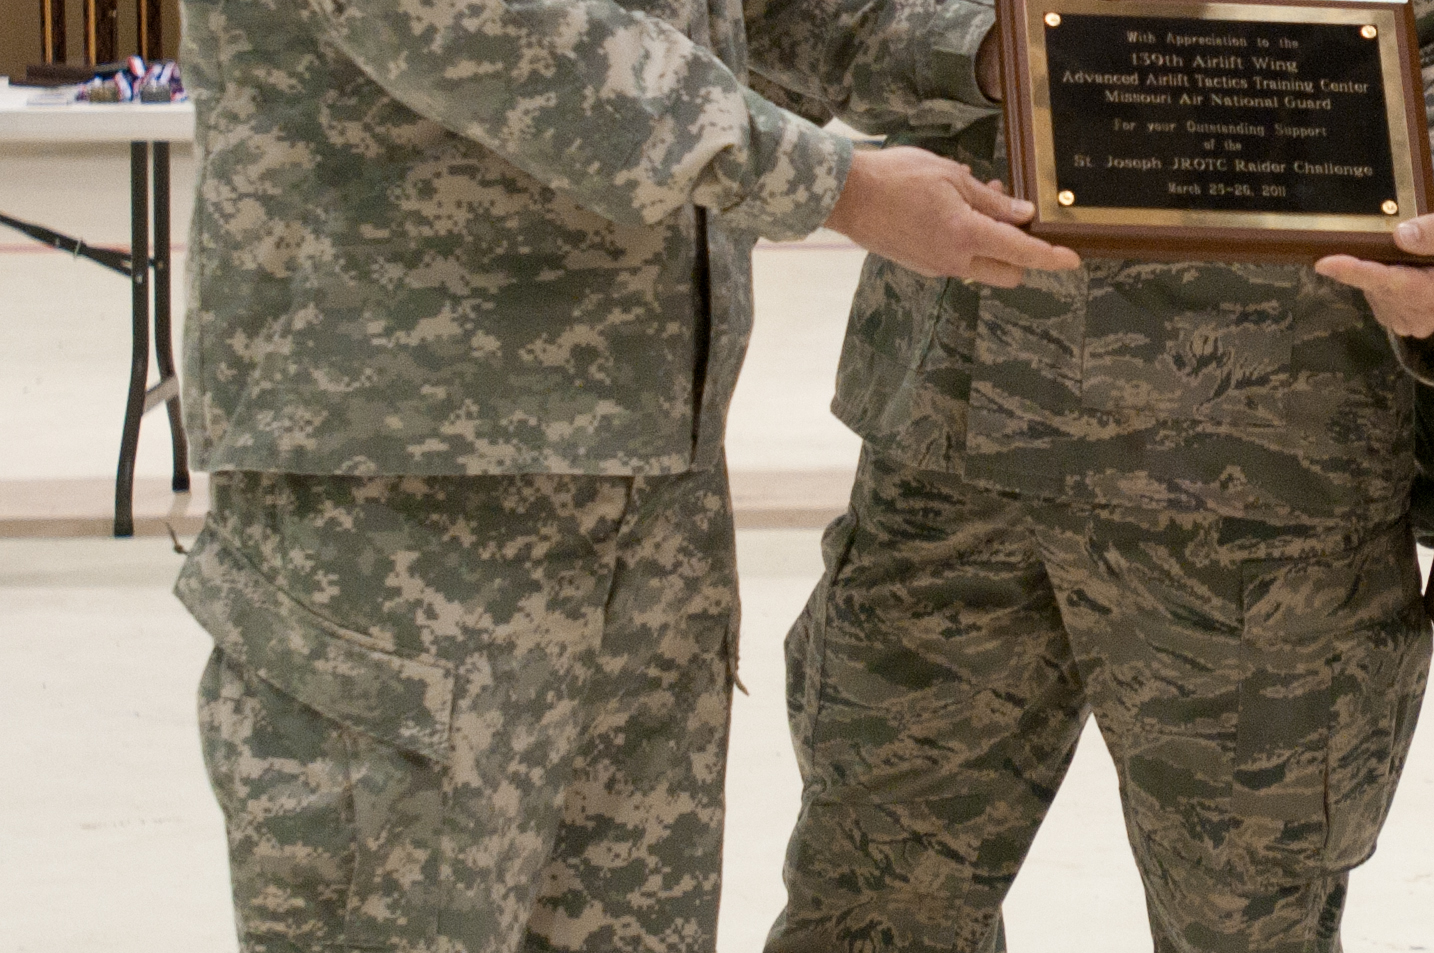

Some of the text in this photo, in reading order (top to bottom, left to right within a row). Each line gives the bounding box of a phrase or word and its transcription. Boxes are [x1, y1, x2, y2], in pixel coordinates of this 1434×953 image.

[1127, 30, 1299, 49] With Appreciation to the
[1131, 51, 1298, 74] 139th Airlift Wing
[1062, 71, 1370, 95] Advanced Airlift Tactics Training Center
[1105, 90, 1332, 110] Missouri Air National Guard
[1114, 117, 1327, 138] For your Outstanding Support
[1203, 139, 1242, 151] of the
[1107, 155, 1162, 170] Joseph
[1173, 157, 1228, 171] JROTC
[1236, 159, 1286, 174] Raider
[1294, 160, 1373, 178] Challenge
[1168, 181, 1200, 196] March
[1261, 185, 1287, 197] 2011
